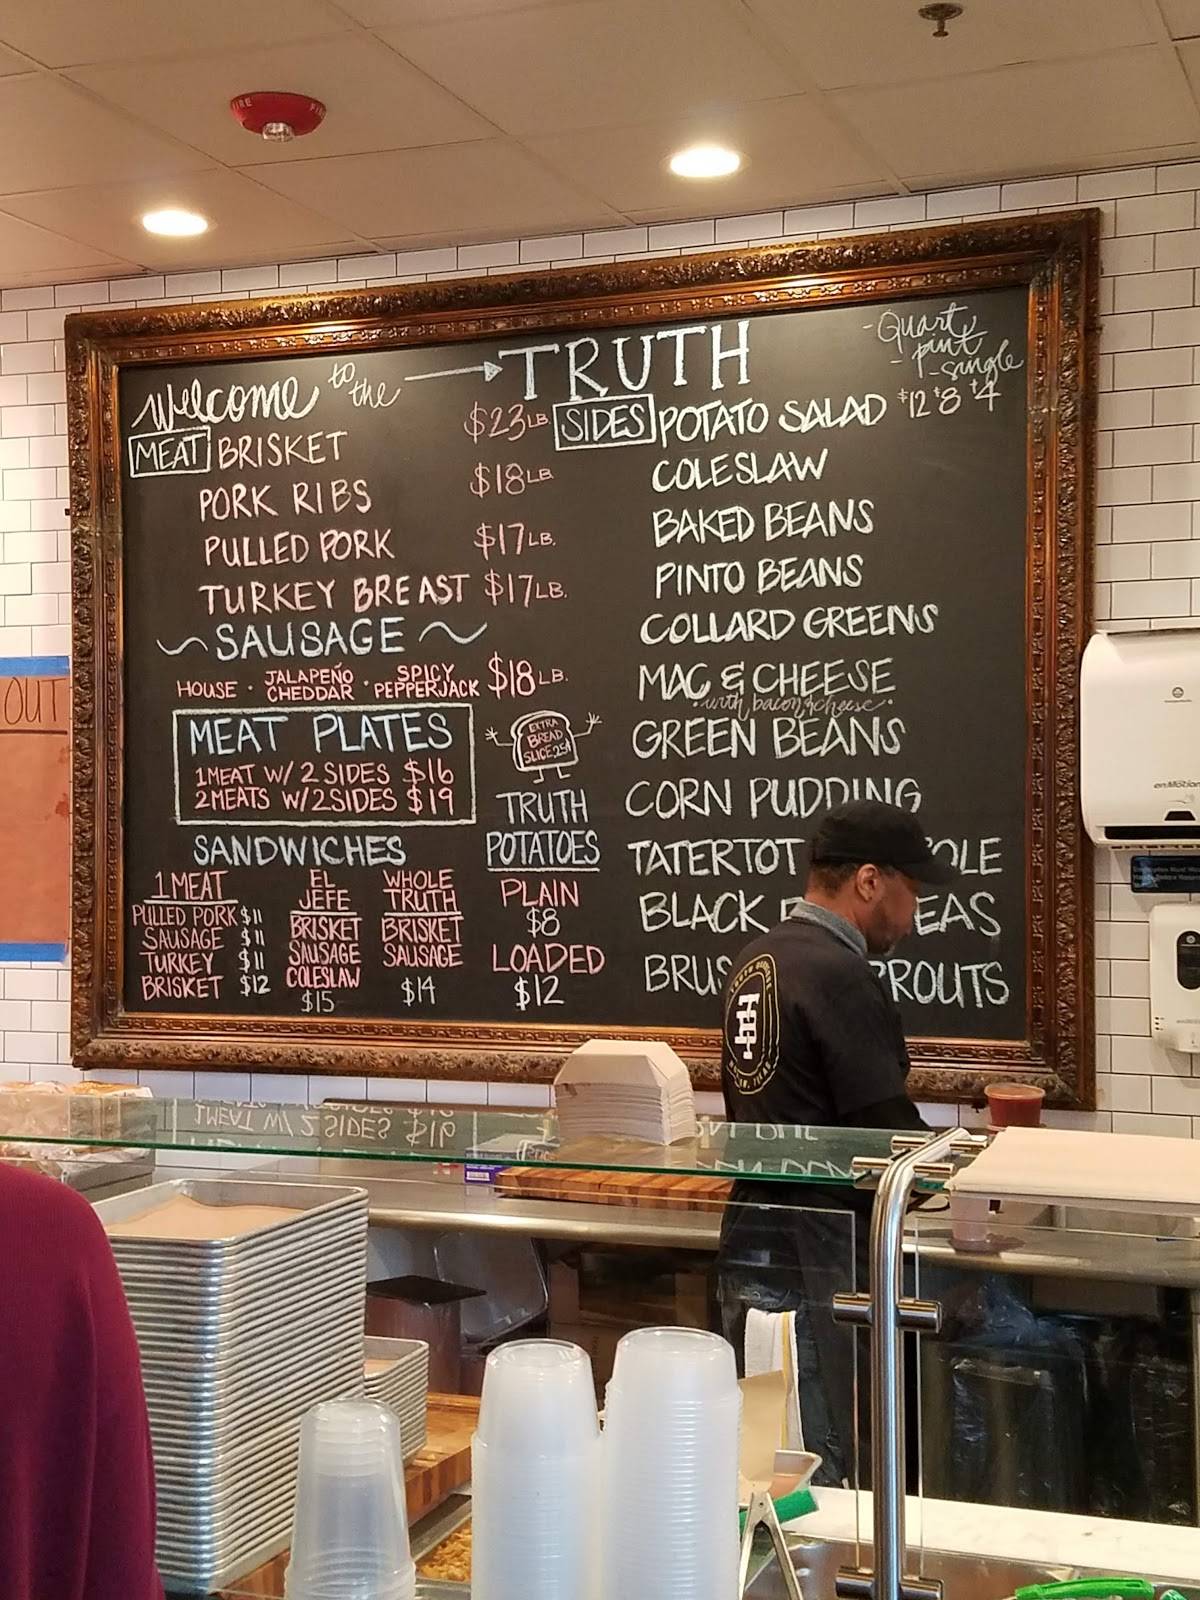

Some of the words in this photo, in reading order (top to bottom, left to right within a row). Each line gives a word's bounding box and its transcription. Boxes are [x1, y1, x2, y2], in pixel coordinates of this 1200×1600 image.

[328, 362, 355, 388] to
[498, 320, 750, 401] TRUTH
[131, 376, 320, 431] Welcome
[348, 378, 400, 408] the
[561, 403, 645, 441] SIDES
[659, 398, 769, 448] POTATO
[779, 393, 887, 433] SALAD
[136, 433, 207, 470] MEAT
[218, 431, 348, 470] BRISKET
[652, 448, 828, 492] COLESLAW
[200, 483, 279, 522] PORK
[293, 479, 372, 515] RIBS
[653, 506, 755, 547] BAKED
[764, 499, 874, 541] BEANS
[205, 531, 310, 567] PULLED
[320, 529, 395, 563] PORK
[656, 561, 745, 599] PINTO
[757, 554, 863, 594] BEANS
[198, 580, 336, 616] TURKEY
[353, 574, 470, 613] BREAST
[216, 616, 405, 662] SAUSAGE
[640, 608, 796, 645] COLLARD
[803, 604, 938, 639] GREENS
[397, 663, 455, 682] SPICY
[638, 663, 711, 701] MAC
[752, 658, 896, 697] CHEESE
[4, 677, 66, 725] OUT
[177, 680, 238, 699] HOUSE
[266, 684, 355, 702] CHEDDAR
[374, 679, 480, 699] PEPPERJACK
[190, 716, 289, 756] MEAT
[313, 711, 453, 753] PLATES
[527, 729, 563, 748] BREAD
[528, 718, 559, 733] EXTRA
[632, 717, 756, 760] GREEN
[772, 716, 906, 759] BEANS
[523, 744, 553, 763] SLICE
[403, 758, 454, 784] $16
[407, 785, 454, 815] $19
[496, 789, 588, 824] TRUTH
[625, 778, 732, 820] CORN
[194, 834, 407, 866] SANDWICHES
[486, 830, 600, 867] POTATOES
[627, 838, 806, 876] TATERTOT
[310, 869, 336, 888] EL
[383, 869, 455, 889] WHOLE
[501, 879, 580, 907] PLAIN
[132, 904, 186, 927] PULLED
[193, 906, 238, 927] PORK
[240, 905, 262, 926] $11
[299, 890, 351, 910] JEFE
[383, 889, 457, 912] TRUTH
[639, 889, 770, 933] BLACK
[914, 891, 1001, 936] EAS
[142, 927, 225, 950] SAUSAGE
[240, 928, 265, 947] $11
[290, 916, 362, 941] BRISKET
[381, 916, 464, 943] BRISKET
[526, 908, 560, 938] $8
[139, 951, 214, 975] TURKEY
[238, 950, 264, 973] $11
[288, 941, 361, 966] SAUSAGE
[383, 944, 464, 968] SAUSAGE
[492, 943, 605, 974] LOADED
[141, 975, 224, 1000] BRISKET
[240, 974, 271, 997] $12
[286, 966, 360, 989] COLESLAW
[401, 975, 436, 1006] $14
[514, 974, 565, 1011] $12
[645, 954, 733, 995] BRUS
[868, 959, 1010, 1008] ROUTS
[301, 990, 335, 1012] $15
